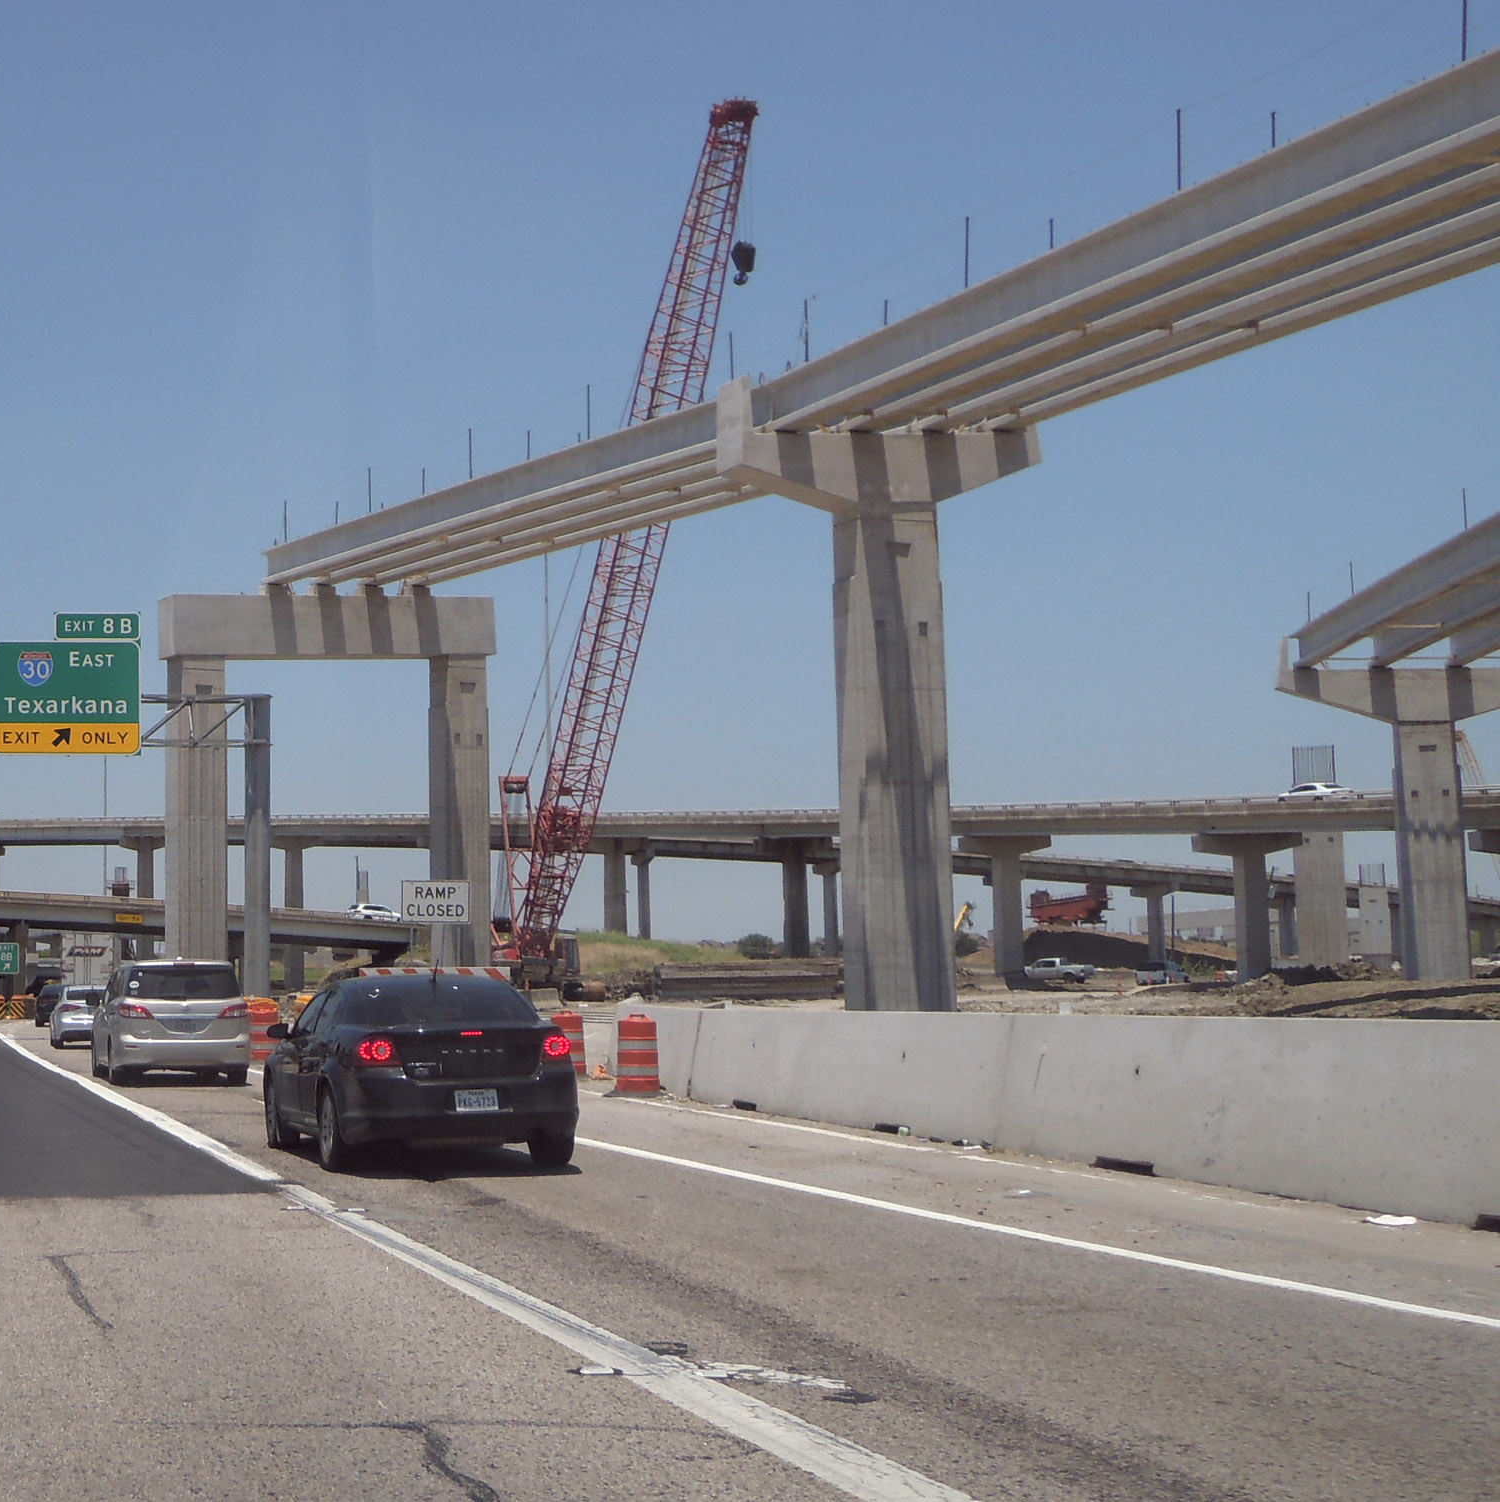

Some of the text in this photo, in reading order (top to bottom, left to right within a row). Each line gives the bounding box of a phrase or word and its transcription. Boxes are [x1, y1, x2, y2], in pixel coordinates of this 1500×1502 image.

[64, 620, 95, 632] EXIT
[69, 651, 115, 667] EAST
[22, 660, 50, 679] 30
[4, 697, 128, 714] Texarkana
[3, 731, 129, 744] EXIT ONLY
[415, 886, 457, 899] RAMP
[406, 903, 465, 917] CLOSED
[0, 952, 13, 961] 8B
